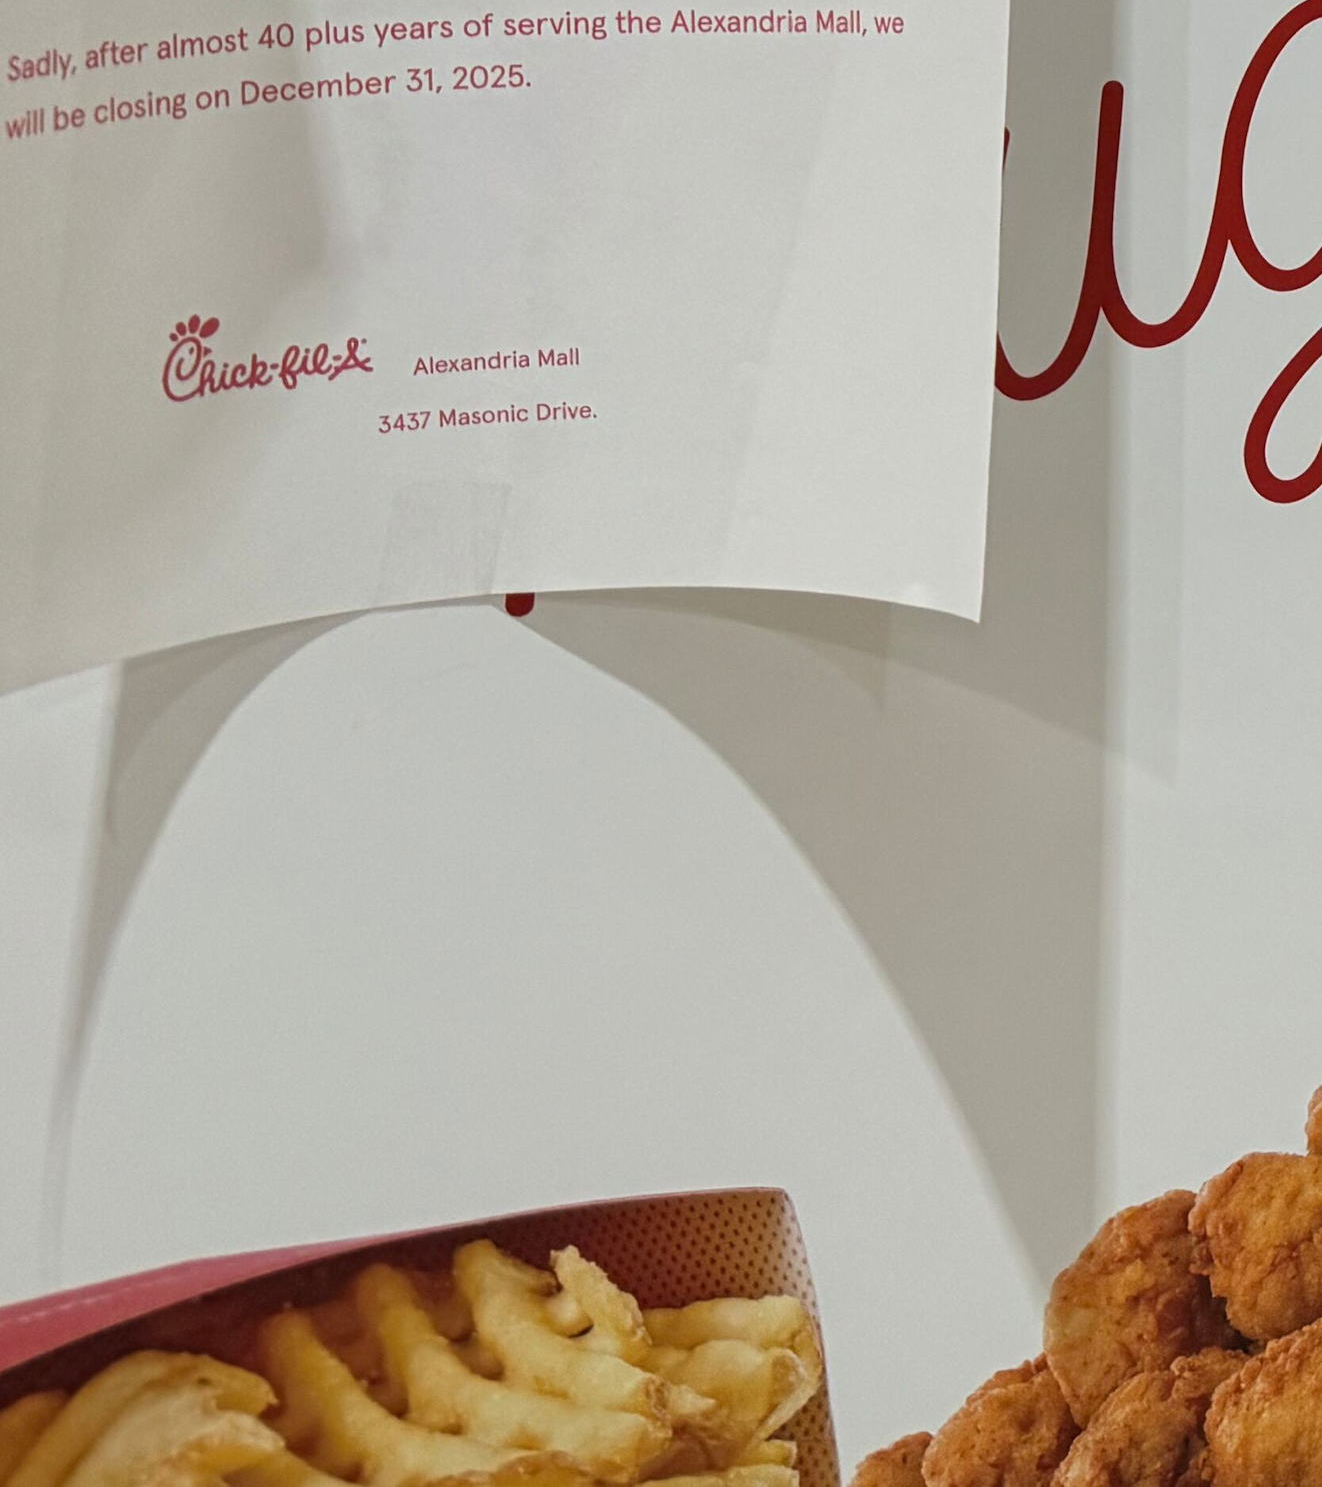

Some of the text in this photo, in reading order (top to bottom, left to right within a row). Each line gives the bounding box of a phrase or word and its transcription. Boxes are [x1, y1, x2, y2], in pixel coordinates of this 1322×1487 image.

[7, 10, 905, 82] Sadly, after almost 40 plus years of serving the Alexandria Mall, we
[3, 63, 532, 141] will be closing on December 31, 2025.
[162, 314, 374, 403] Chick-fil-A
[413, 348, 581, 376] Alexandria Mall
[379, 402, 597, 434] 3437 Masonic Drive.
